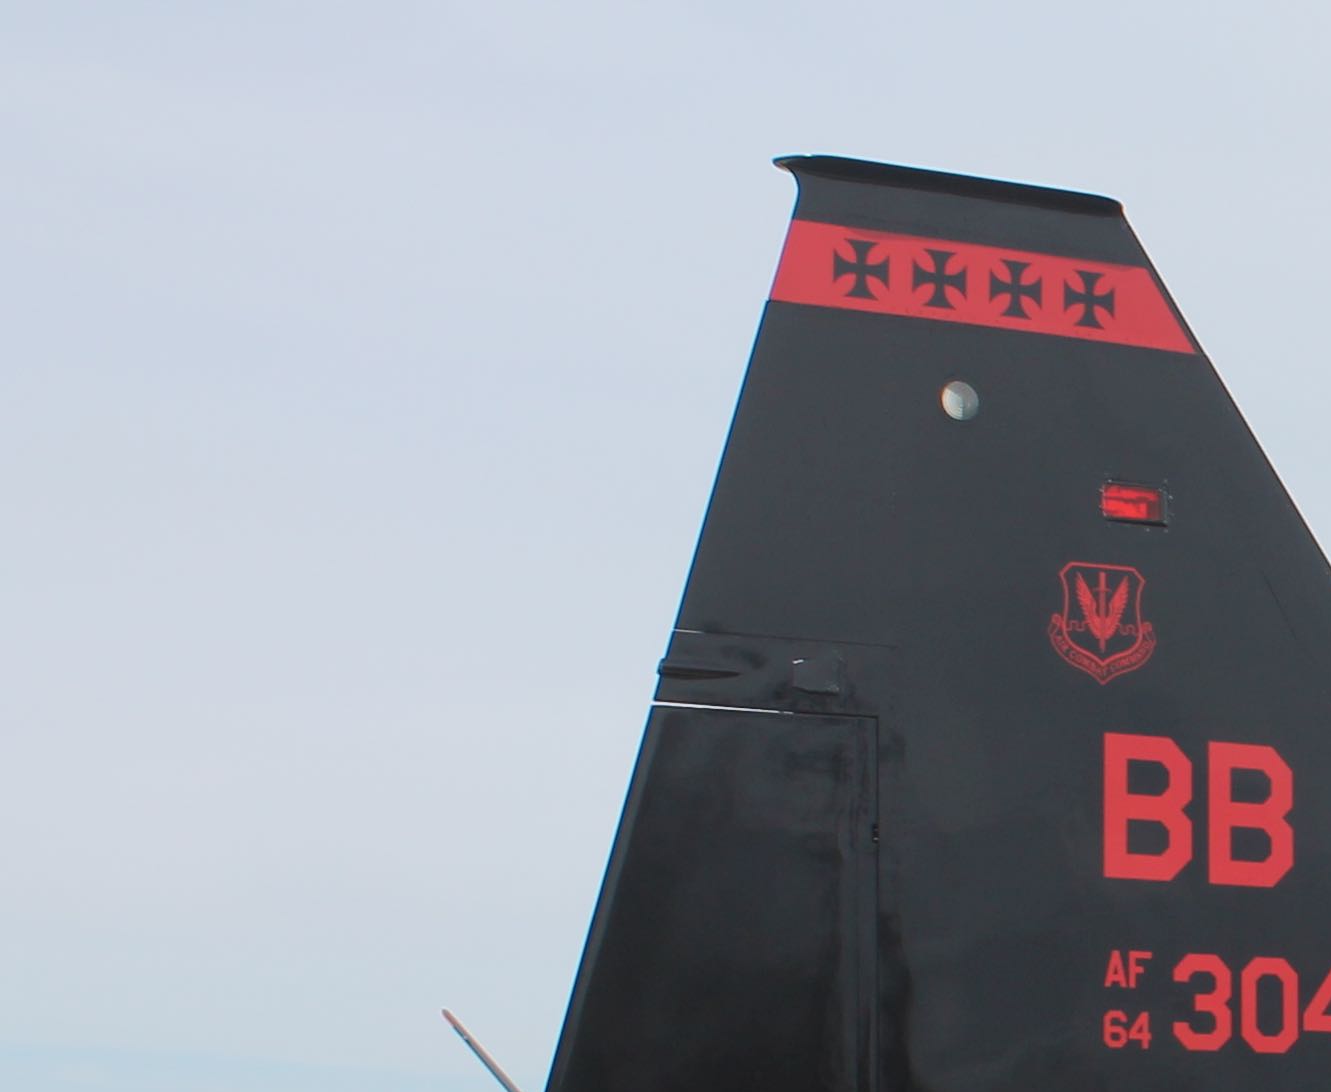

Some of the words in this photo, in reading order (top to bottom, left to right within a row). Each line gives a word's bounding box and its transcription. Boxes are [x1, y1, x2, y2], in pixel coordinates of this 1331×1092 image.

[1103, 731, 1295, 889] BB
[1103, 950, 1153, 989] AF
[1102, 1009, 1152, 1050] 64
